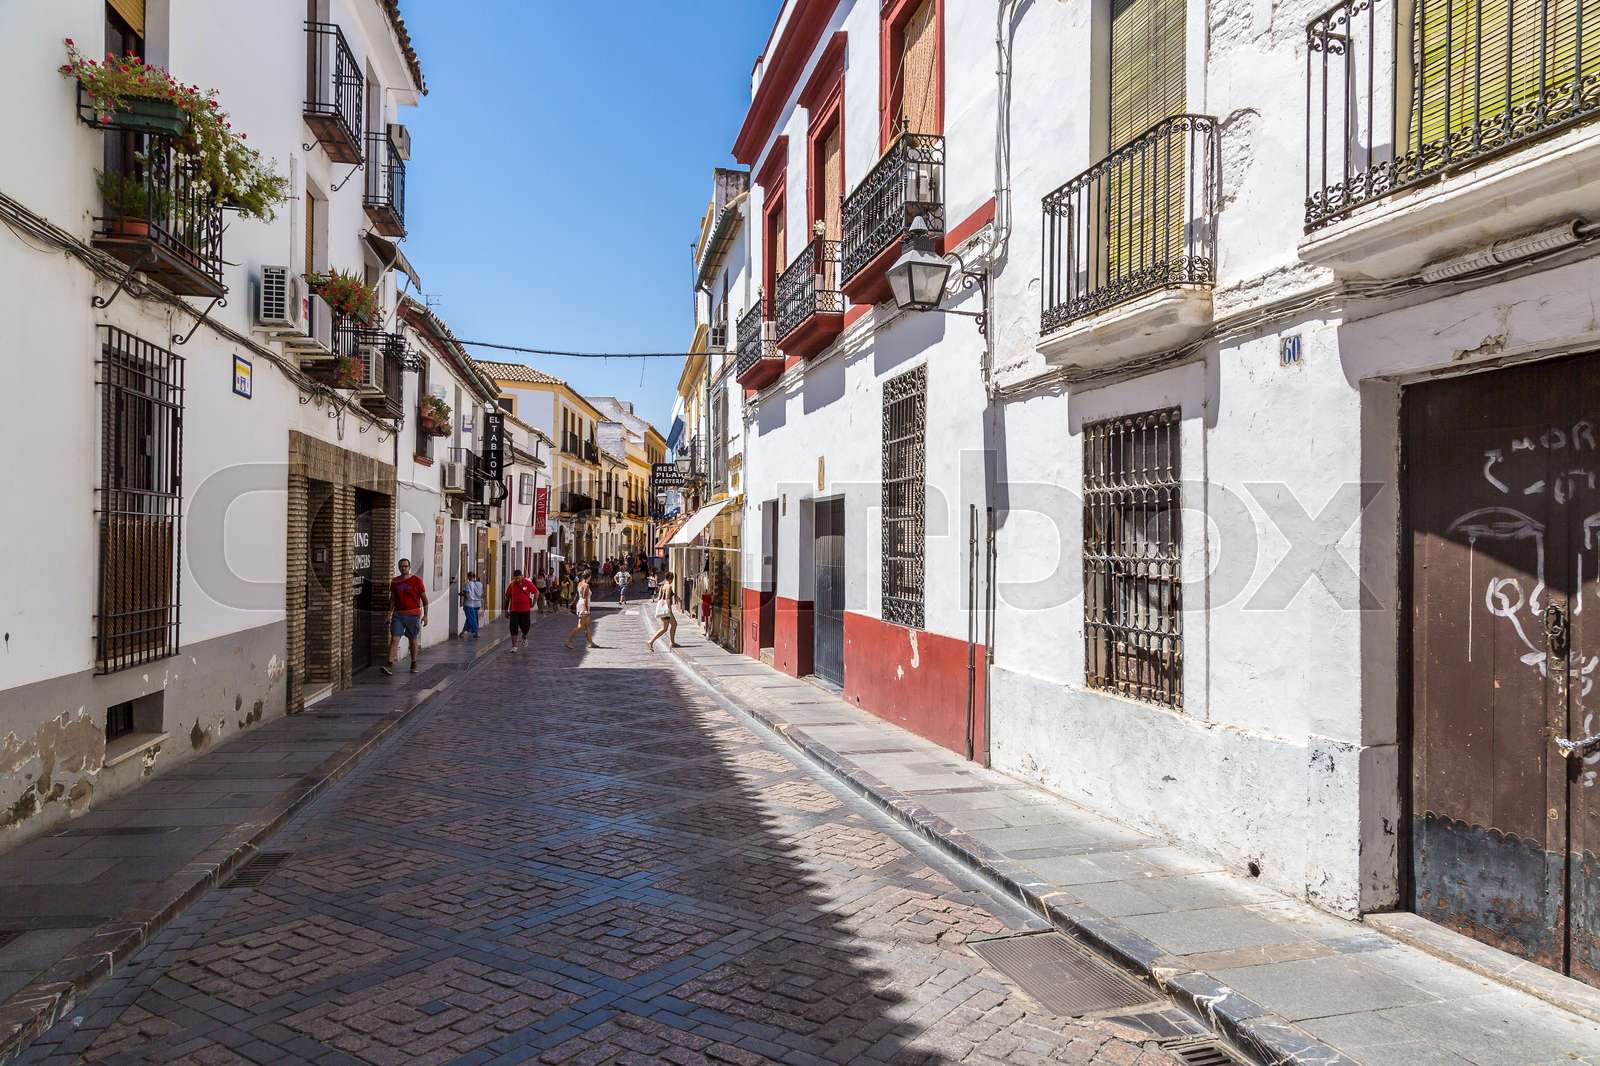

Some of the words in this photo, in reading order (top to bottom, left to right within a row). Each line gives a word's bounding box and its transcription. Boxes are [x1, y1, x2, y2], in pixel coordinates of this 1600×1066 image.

[1283, 335, 1301, 365] 60
[489, 416, 500, 424] EL
[489, 425, 498, 477] TABLON
[537, 493, 546, 513] TAPAS
